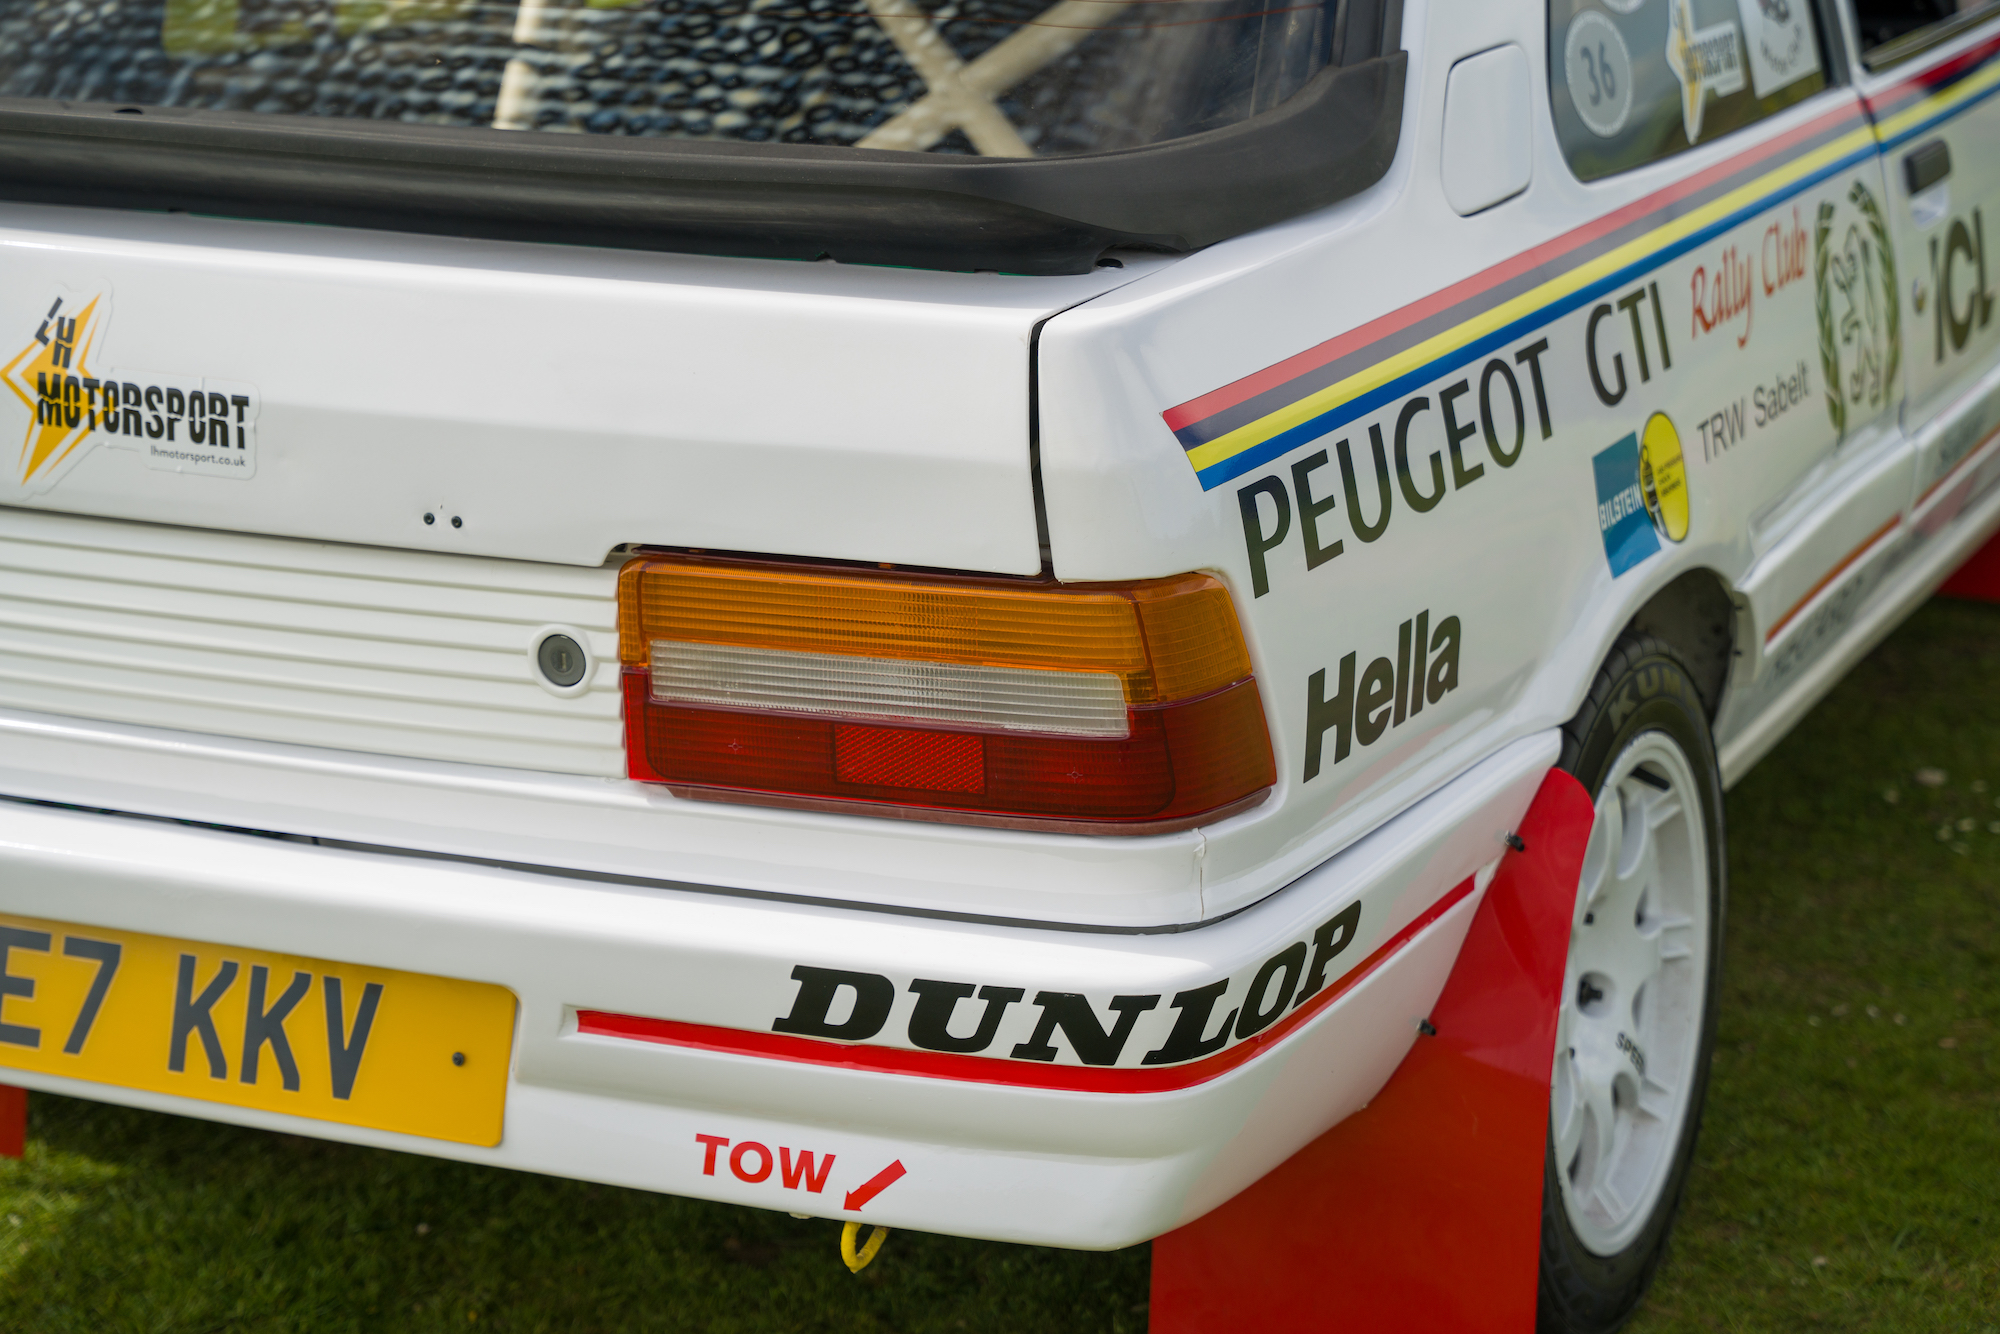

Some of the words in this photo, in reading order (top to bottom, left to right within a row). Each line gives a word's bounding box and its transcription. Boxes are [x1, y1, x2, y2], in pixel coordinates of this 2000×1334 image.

[1580, 40, 1616, 107] 36
[1690, 263, 1753, 350] Rally
[1761, 204, 1808, 299] Club
[37, 371, 250, 450] MOTORSPORT
[150, 445, 246, 468] lhmotorsport.co.uk
[1237, 337, 1553, 599] PEUGEOT
[1585, 280, 1672, 407] GTI
[1696, 396, 1746, 464] TRW
[1753, 359, 1810, 429] Sabelt
[1599, 482, 1644, 532] BILSTEIN
[1303, 609, 1461, 784] Hella
[0, 925, 122, 1056] E7
[168, 953, 385, 1101] KKV
[772, 900, 1362, 1067] DUNLOP
[695, 1133, 836, 1195] TOW
